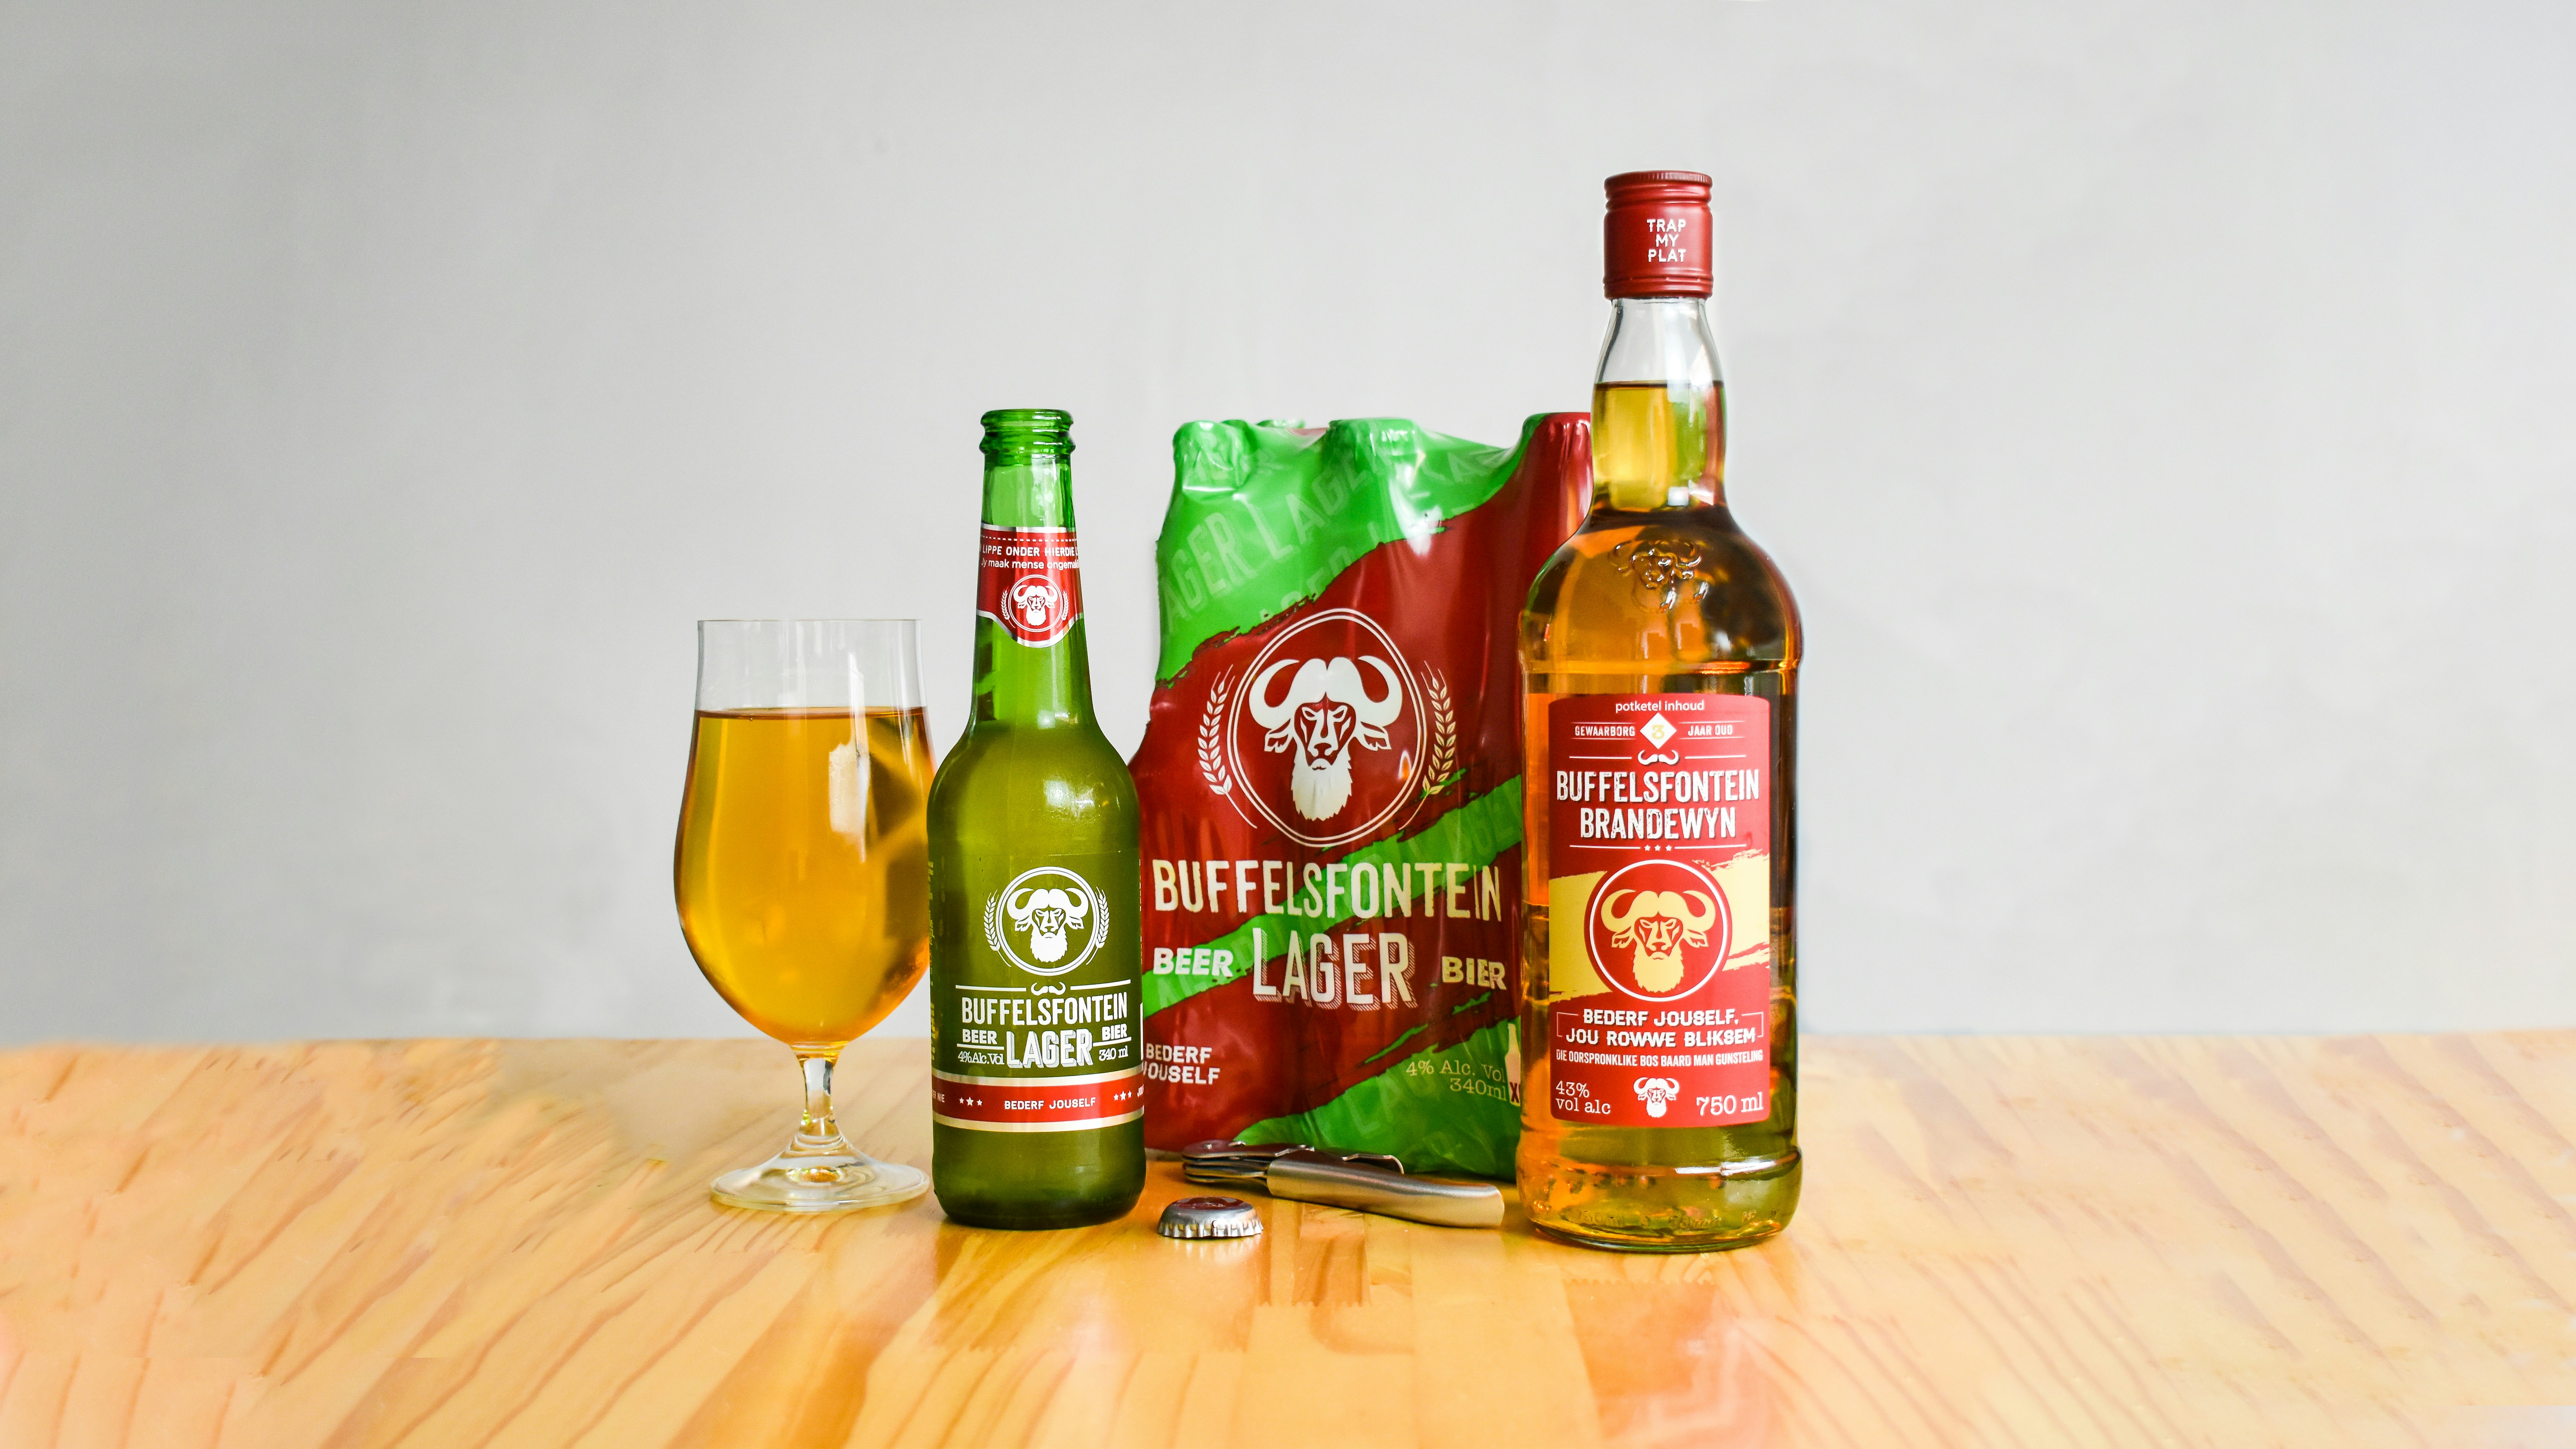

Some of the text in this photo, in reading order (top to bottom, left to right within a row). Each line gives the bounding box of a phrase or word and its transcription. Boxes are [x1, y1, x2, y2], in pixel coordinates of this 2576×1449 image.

[1646, 219, 1686, 232] TRAP
[1656, 234, 1679, 247] MY
[1648, 249, 1686, 262] PLAT
[983, 545, 1002, 555] LIPPE
[1006, 547, 1040, 557] ONDER
[1045, 547, 1074, 557] HIERDIE
[989, 559, 1010, 568] maak
[1616, 700, 1704, 714] potketel inhoud
[1575, 726, 1636, 737] GEWAARBORG
[1652, 725, 1665, 739] 3
[1688, 724, 1733, 736] JAAR OUD
[1557, 769, 1759, 803] BUFFELSFONTEIN
[1581, 806, 1738, 839] BRANDEWYN
[1152, 859, 1502, 922] BUFFELSFONTEIN
[1153, 947, 1233, 977] BEER
[1252, 927, 1418, 1011] LAGER
[1441, 956, 1507, 990] BIER
[962, 991, 1128, 1026] BUFFELSFONTEIN
[1583, 1009, 1649, 1026] BEDERF
[962, 1029, 998, 1045] BEER
[1102, 1024, 1128, 1041] BIER
[1566, 1028, 1756, 1048] JOU ROWWE BLIKSEM
[1006, 1029, 1094, 1069] LAGER
[1099, 1045, 1129, 1062] 340 ml
[1146, 1043, 1212, 1064] BEDERF
[1557, 1049, 1763, 1067] DIE OORSPRONKLIKE BOS BAARD MAN GUNSTELING
[1406, 1060, 1506, 1082] 4% Alc. Vol
[1556, 1081, 1590, 1098] 43%
[1005, 1097, 1096, 1110] BEDERF JOUSELF
[1556, 1098, 1611, 1115] vol alc
[1696, 1092, 1764, 1116] 750 ml
